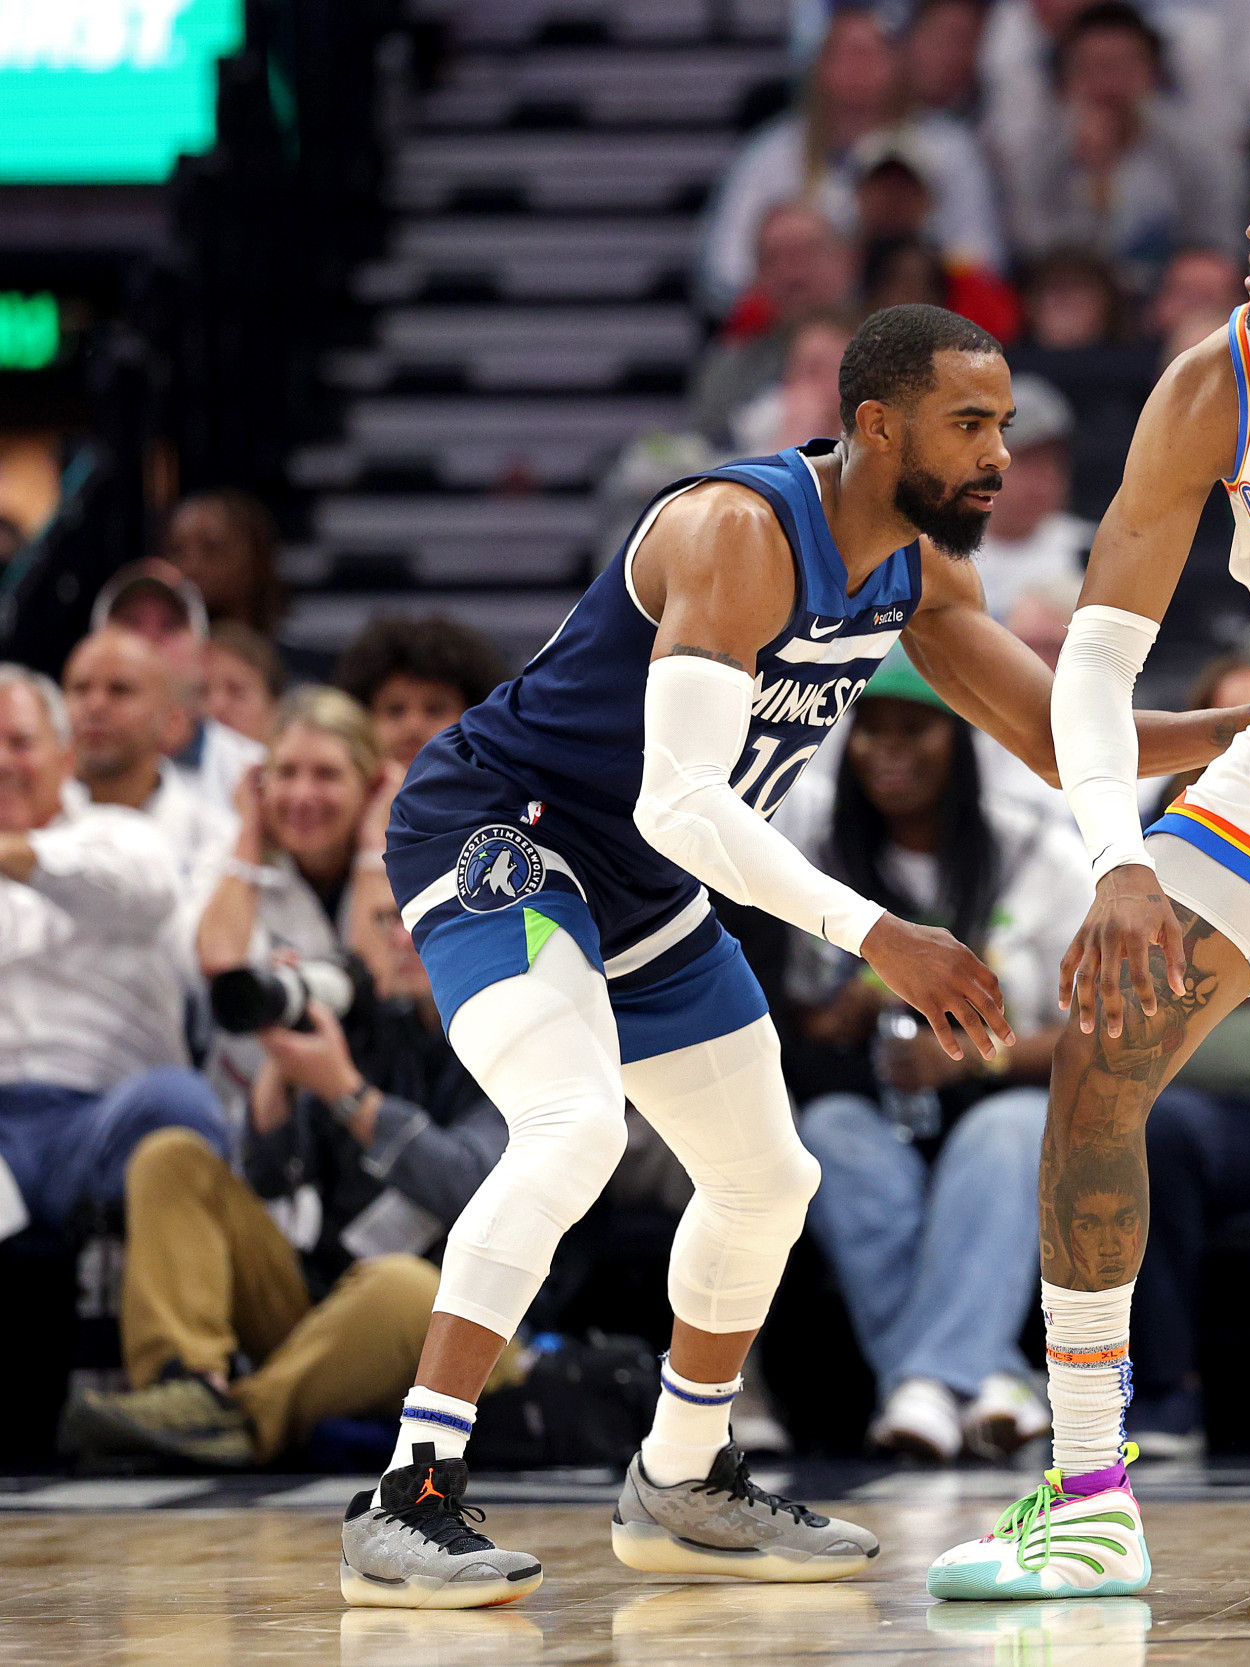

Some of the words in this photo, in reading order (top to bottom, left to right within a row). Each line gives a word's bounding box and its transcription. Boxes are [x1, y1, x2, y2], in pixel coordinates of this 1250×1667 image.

[732, 735, 819, 823] 10
[458, 833, 488, 897] MINNESOTA
[493, 829, 541, 894] TIMBERWOLVES
